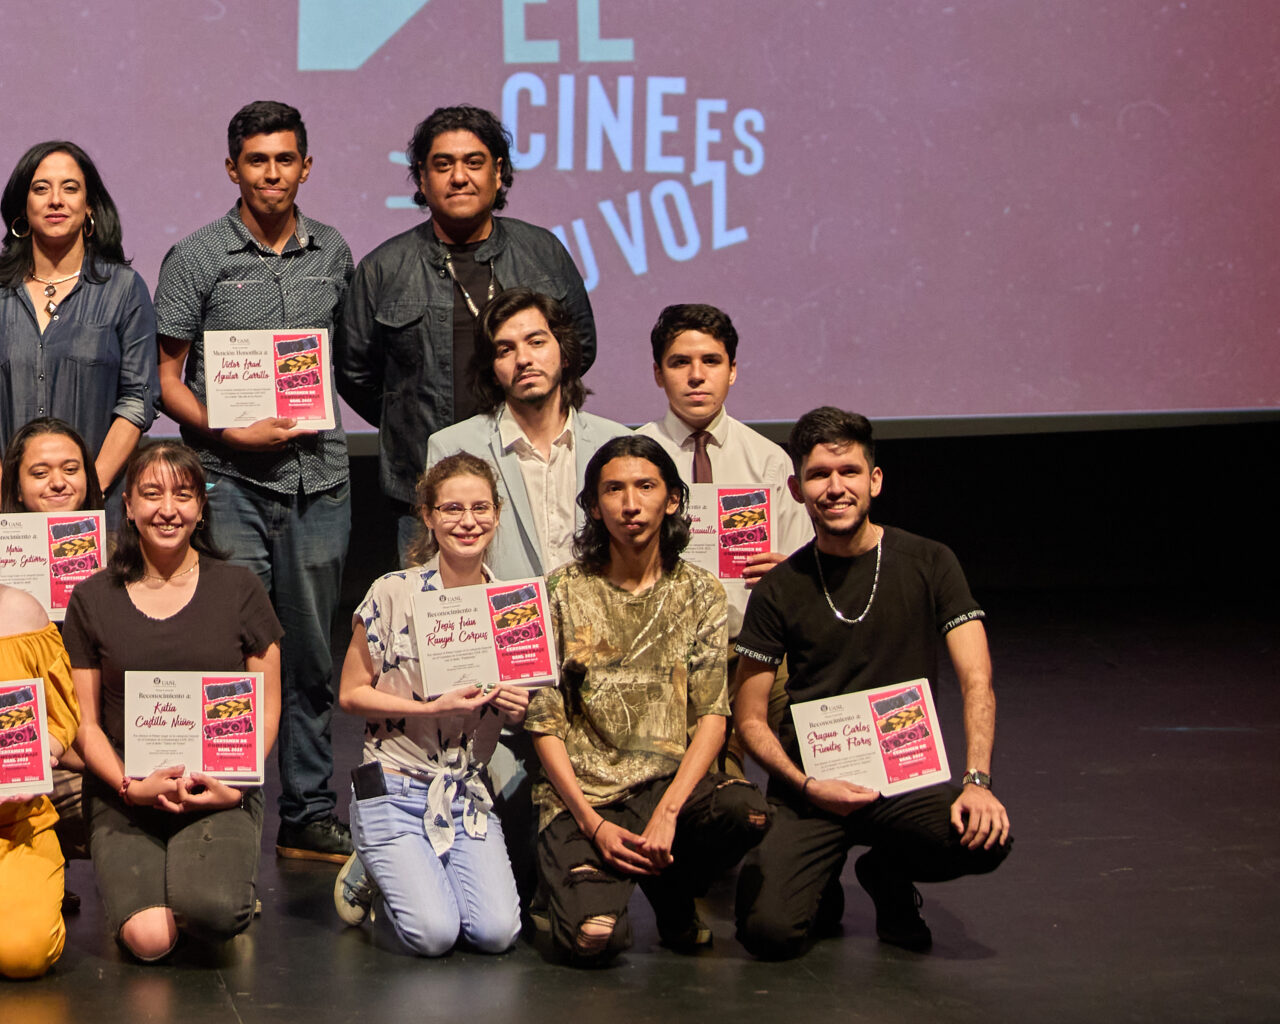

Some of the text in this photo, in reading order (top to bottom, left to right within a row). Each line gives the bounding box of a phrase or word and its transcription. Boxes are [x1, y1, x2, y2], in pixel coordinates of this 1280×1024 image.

[502, 72, 765, 176] CINE ES
[552, 160, 750, 293] U VOZ
